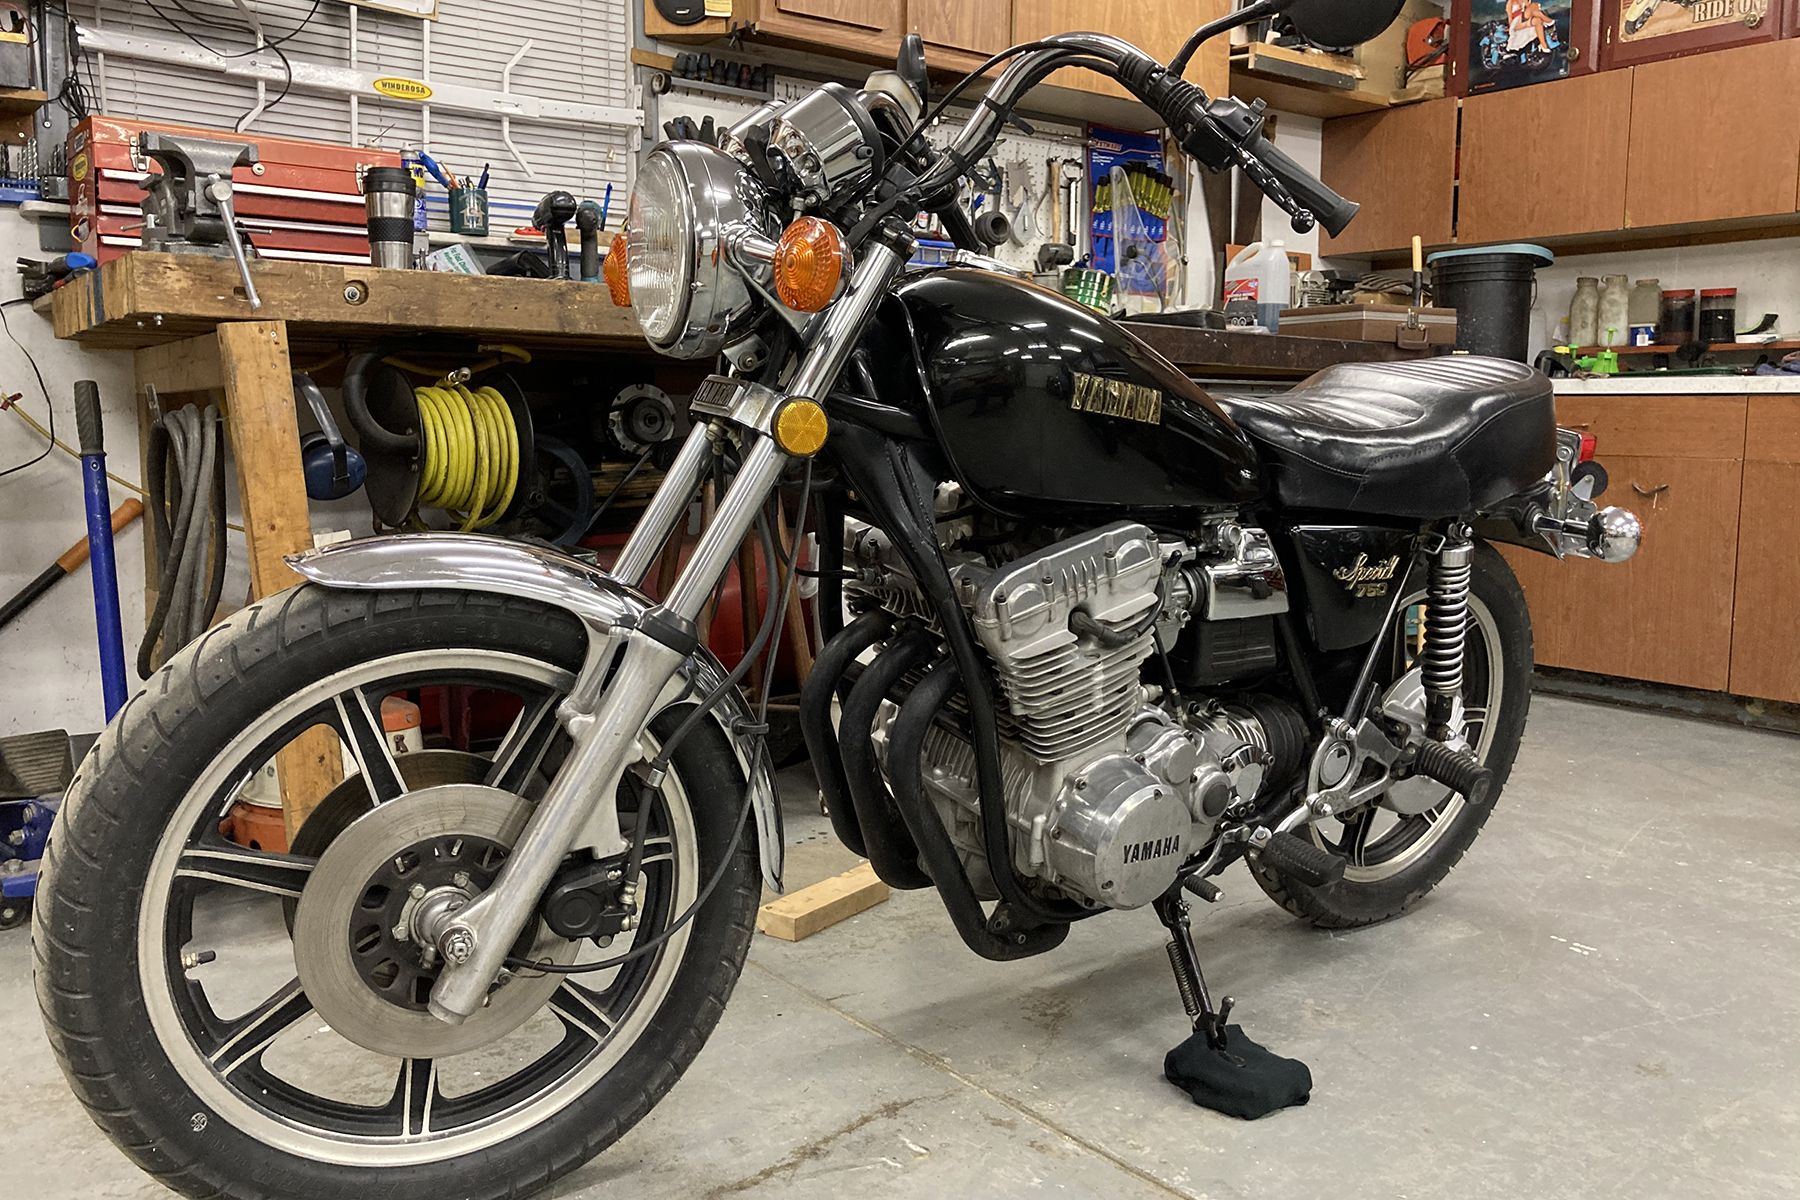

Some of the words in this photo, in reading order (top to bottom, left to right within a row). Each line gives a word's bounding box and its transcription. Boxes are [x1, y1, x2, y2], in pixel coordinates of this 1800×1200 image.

[1693, 0, 1734, 23] RIDE
[381, 81, 426, 94] WINDEROSA
[1071, 372, 1162, 425] YAMAHA
[1355, 583, 1387, 597] 750
[1123, 834, 1180, 864] YAMAHA
